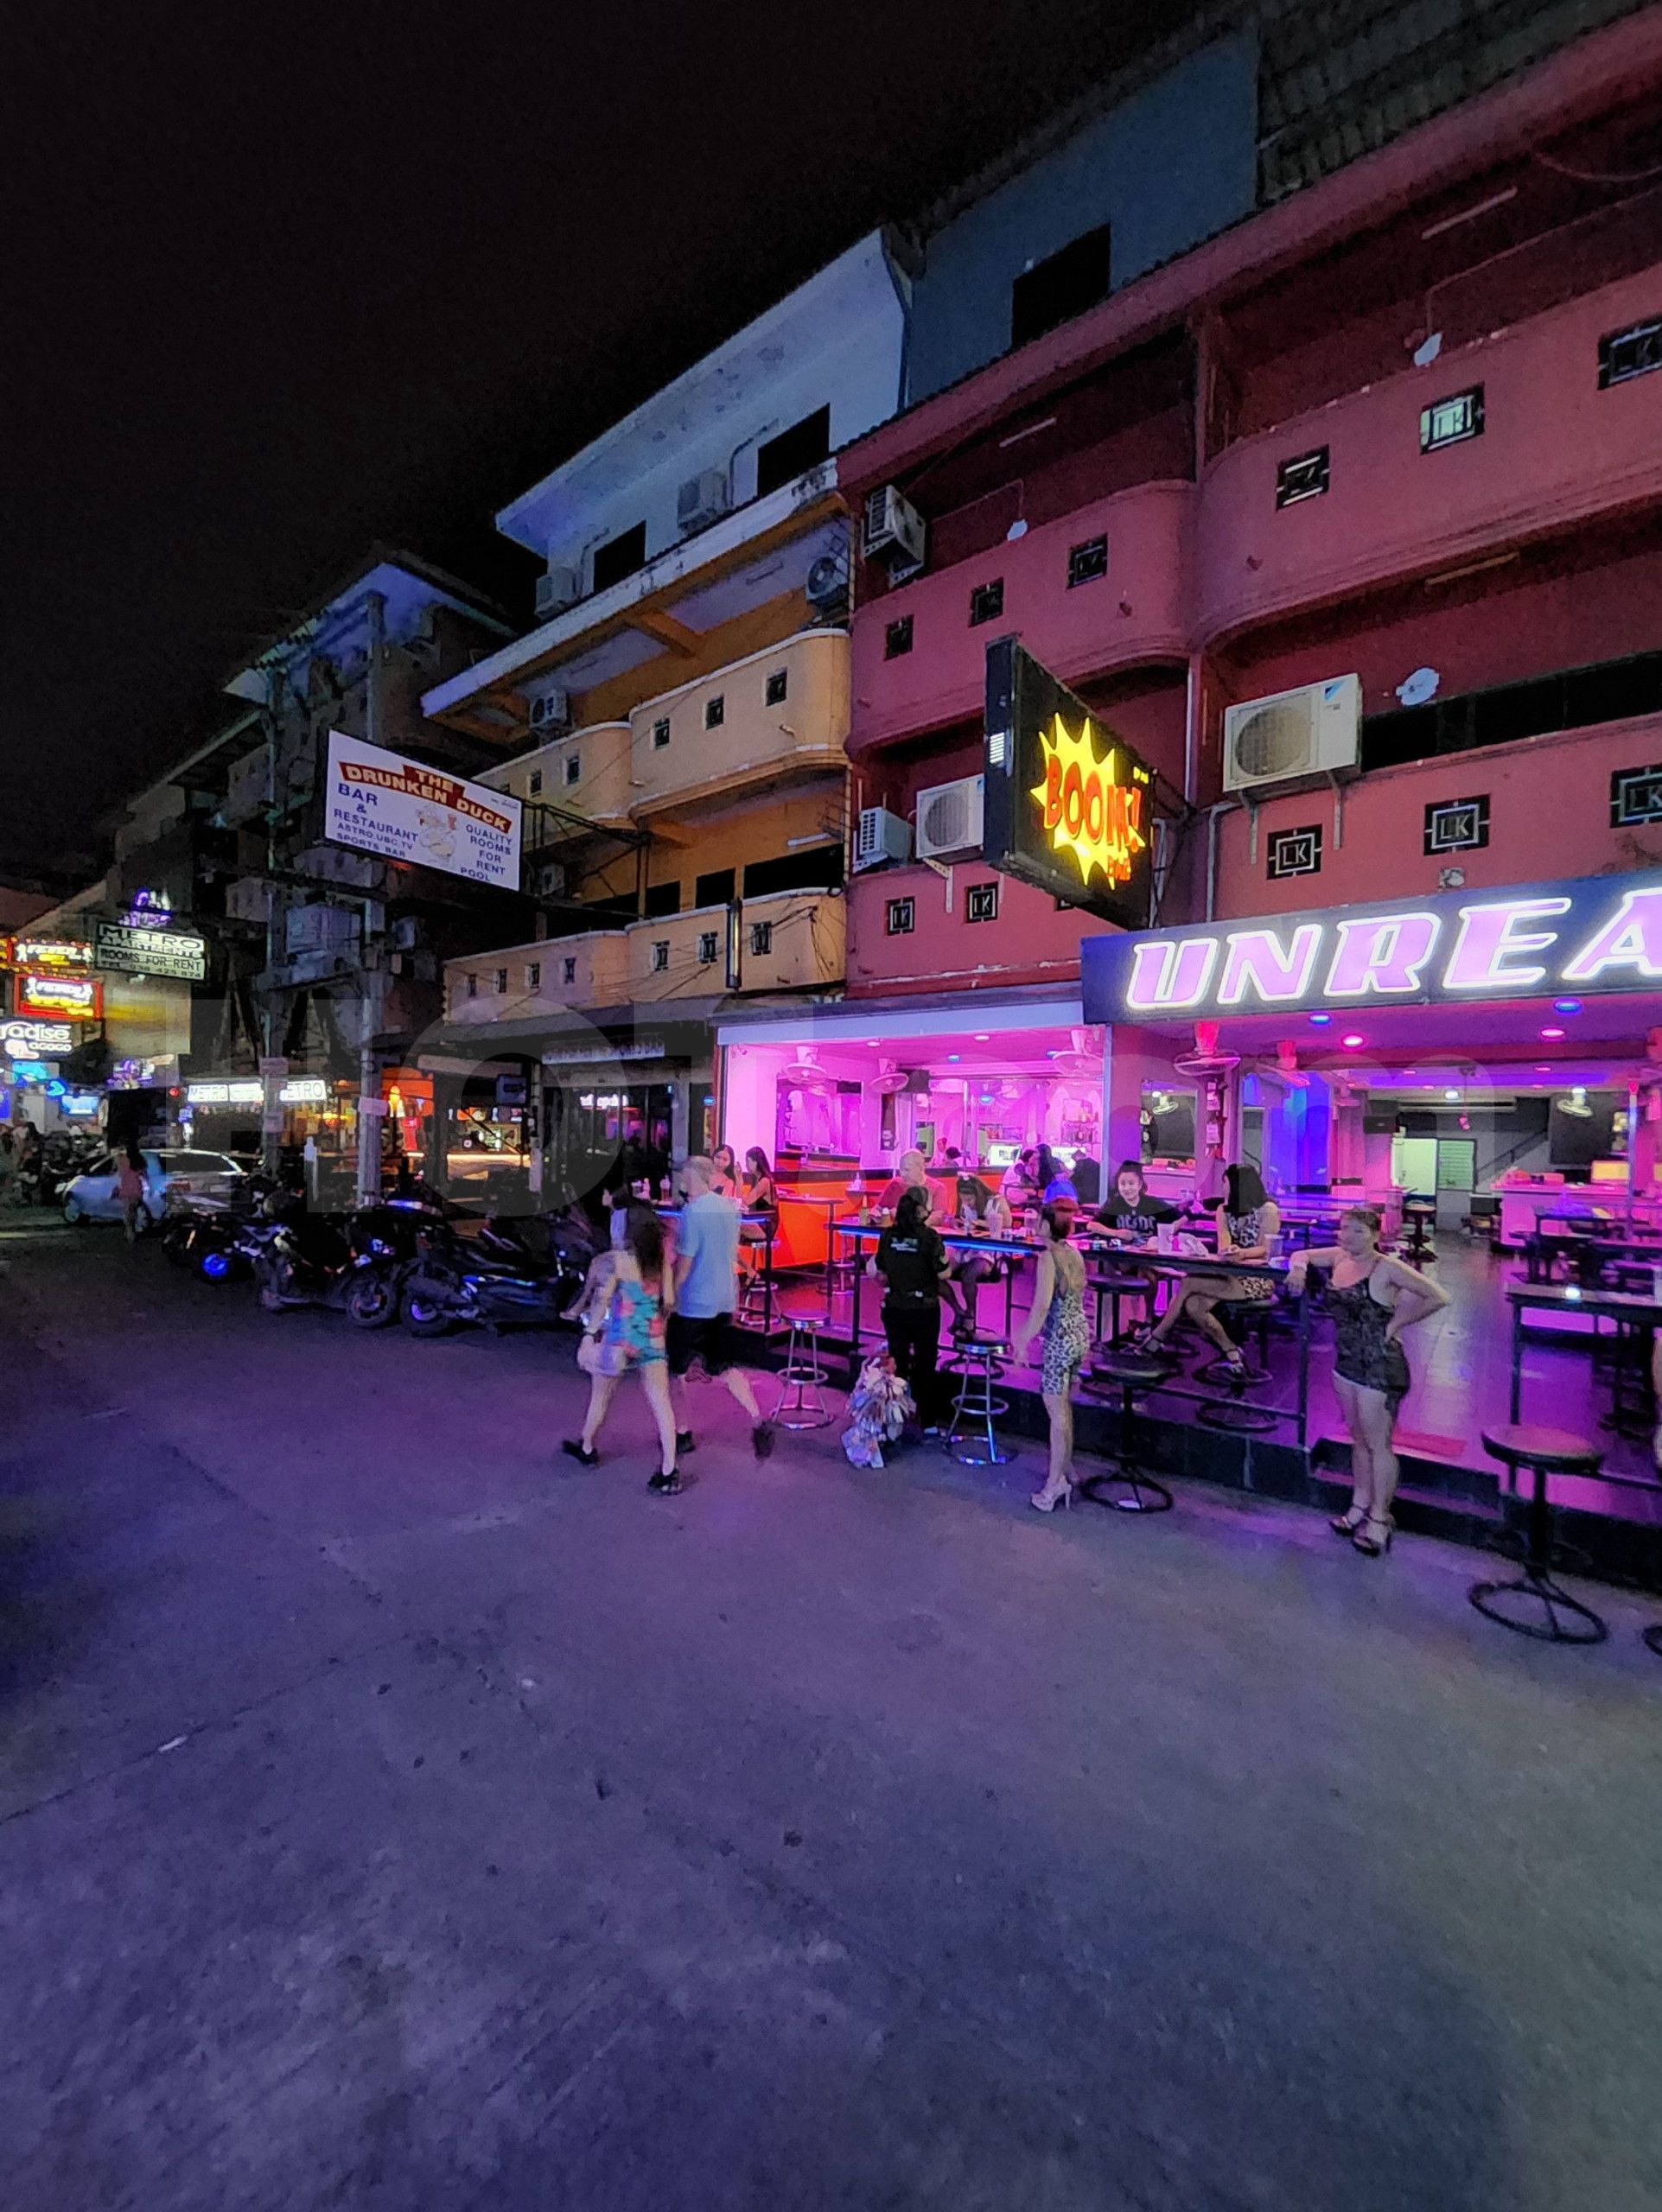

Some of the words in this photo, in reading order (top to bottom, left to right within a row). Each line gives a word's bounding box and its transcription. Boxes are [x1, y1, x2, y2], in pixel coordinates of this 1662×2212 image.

[415, 768, 454, 792] THE
[339, 783, 378, 805] BAR
[346, 766, 448, 804] DRUNKEN
[456, 798, 507, 831] DUCK
[1044, 753, 1142, 854] BOOM!
[356, 803, 366, 814] &
[334, 808, 418, 842] RESTAURANT
[466, 823, 513, 845] QUALITY
[337, 832, 379, 850] SPORTS
[385, 847, 406, 858] BAR
[470, 836, 512, 855] ROOMS
[479, 849, 501, 863] FOR
[461, 867, 491, 881] POOL
[476, 860, 506, 875] RENT
[102, 925, 201, 950] METRO
[101, 948, 140, 963] ROOMS
[146, 954, 167, 966] FOR
[174, 958, 201, 971] RENT
[283, 1081, 323, 1099] ETRO
